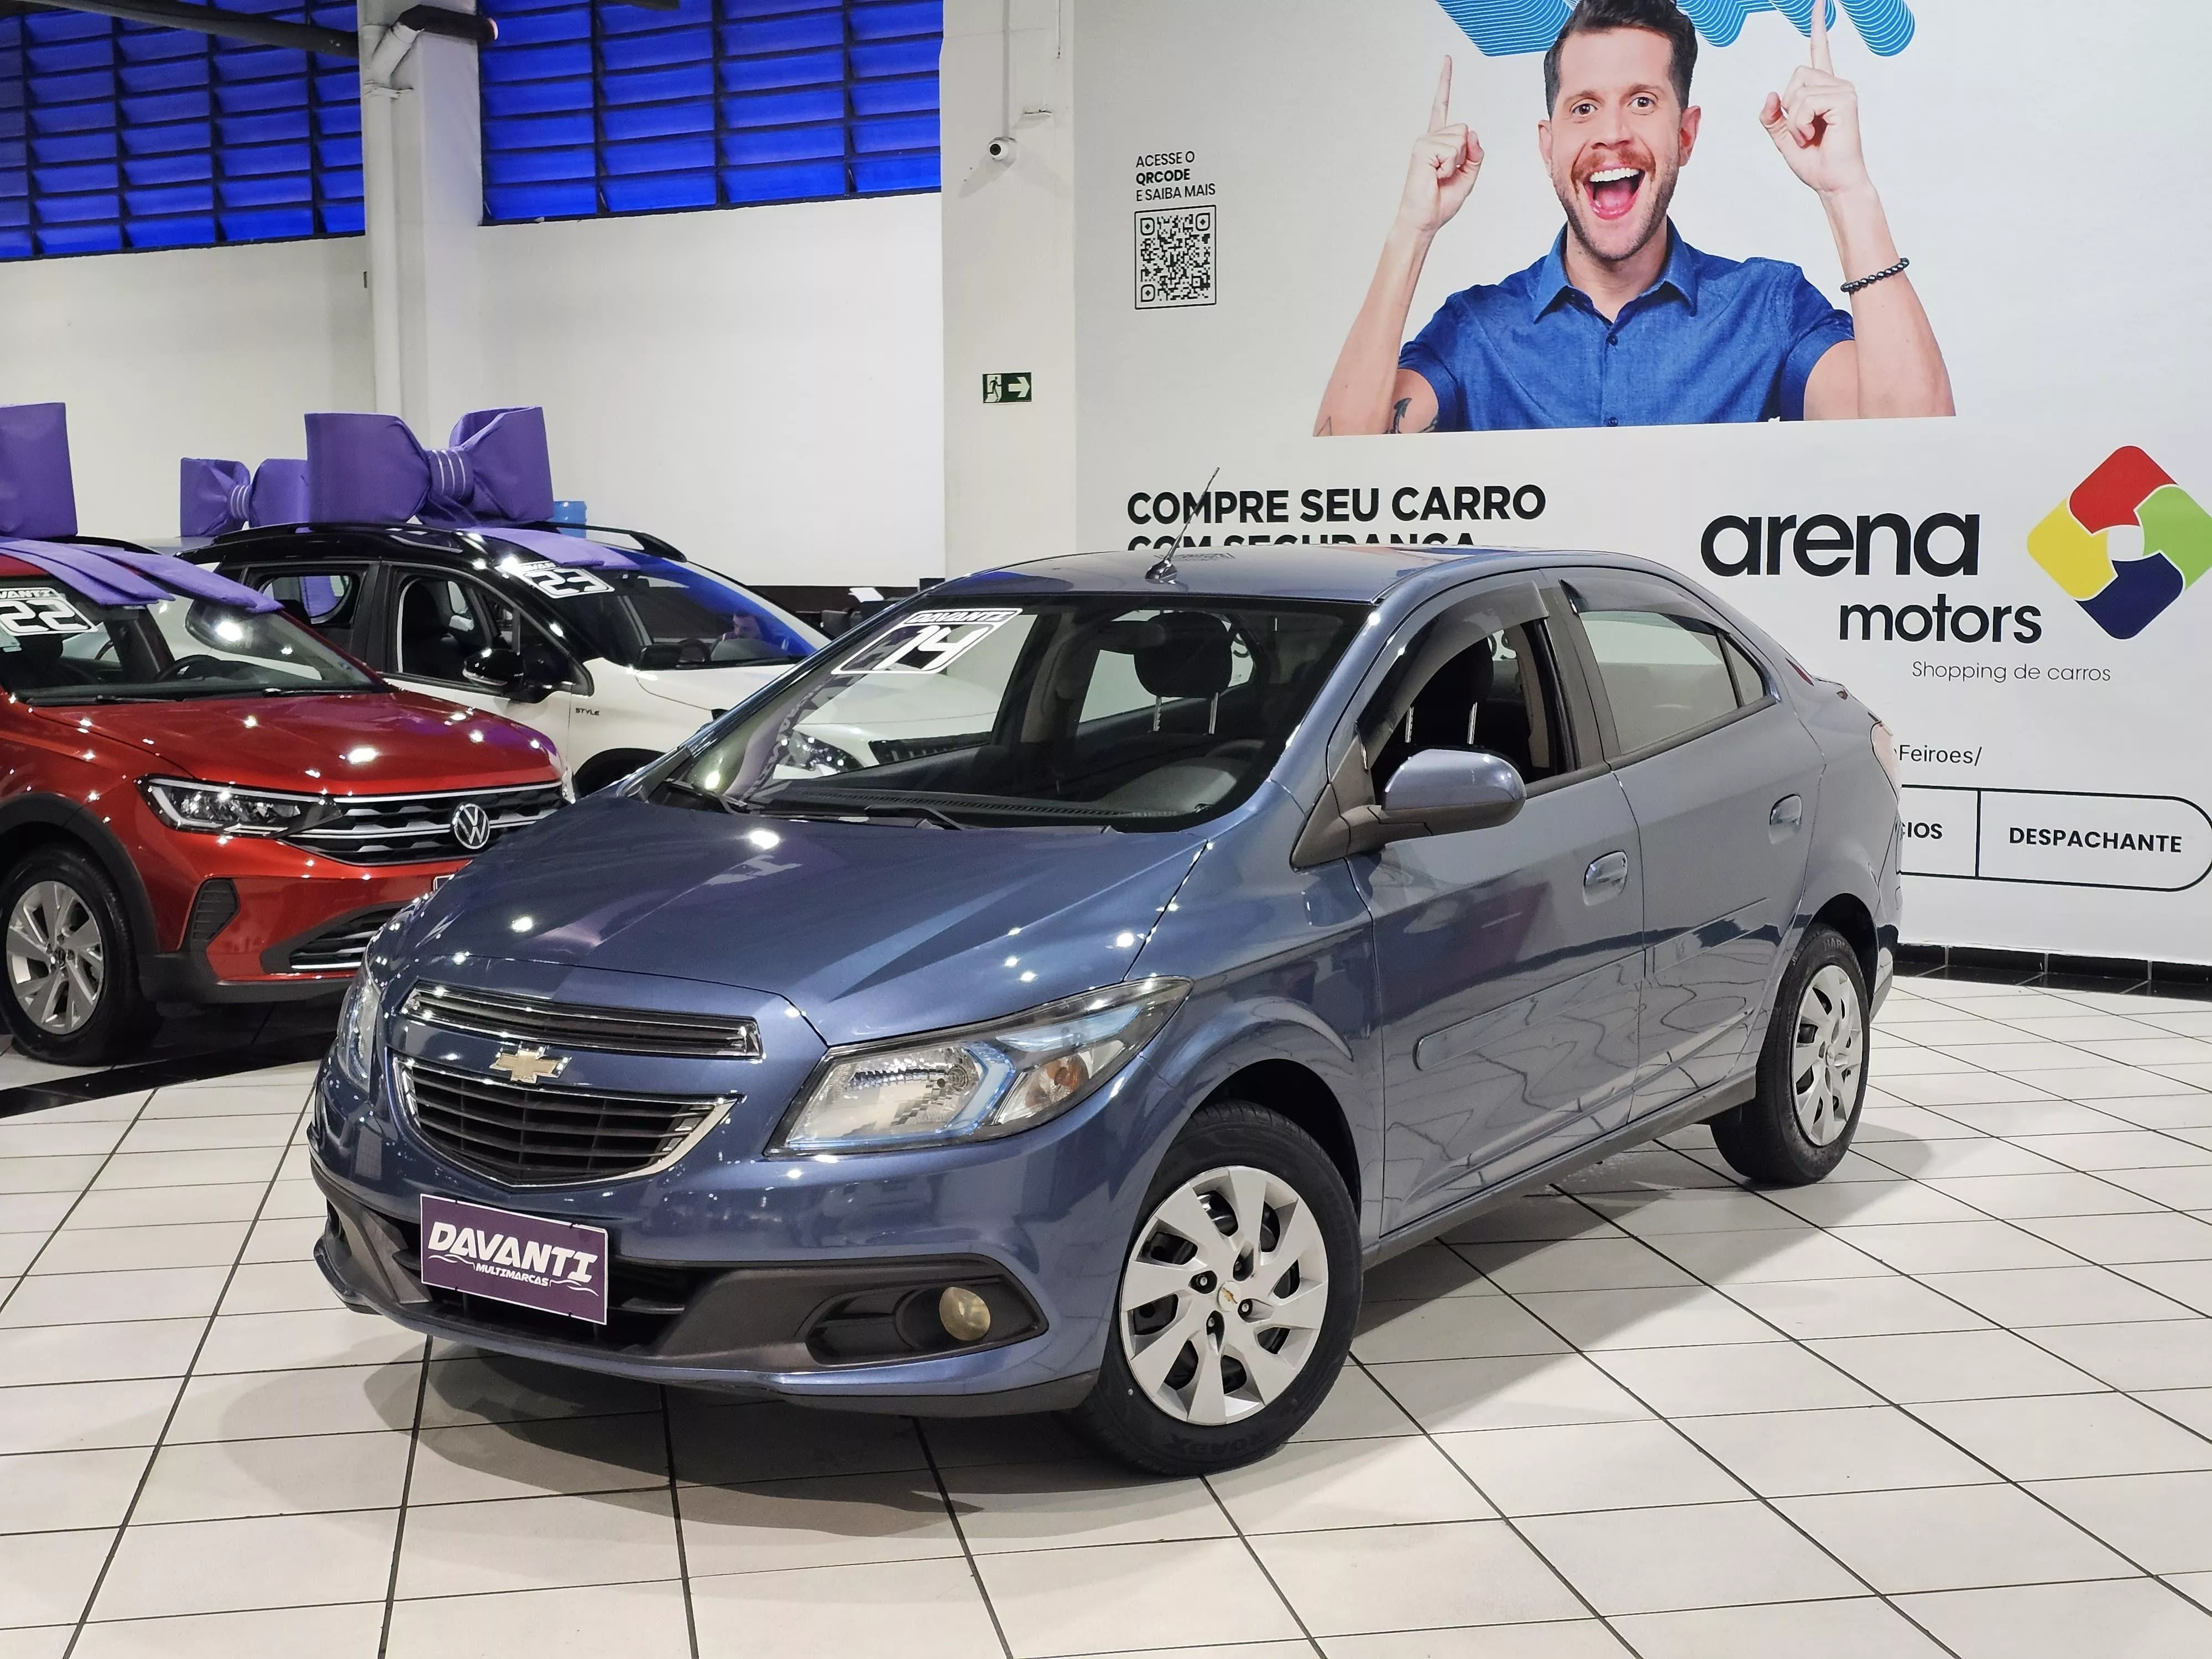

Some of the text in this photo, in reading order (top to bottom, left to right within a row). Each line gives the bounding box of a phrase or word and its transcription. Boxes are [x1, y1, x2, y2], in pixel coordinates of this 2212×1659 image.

[1135, 150, 1195, 168] ACESSE O
[1136, 168, 1191, 186] QRCODE
[1136, 183, 1216, 201] E SAIBA MAIS
[1128, 484, 1546, 524] COMPRE SEU CARRO
[1700, 512, 1980, 577] arena
[524, 568, 607, 596] 23
[0, 599, 88, 633] 22
[1839, 593, 2042, 644] motors
[872, 625, 989, 670] 14
[1912, 661, 2111, 683] Shopping de carros
[575, 708, 600, 716] STYLE
[1893, 744, 1983, 766] Feiroes/
[2009, 827, 2182, 853] DESPACHANTE
[427, 1221, 598, 1283] DAVANTI
[475, 1262, 549, 1287] MULTIMARCAS
